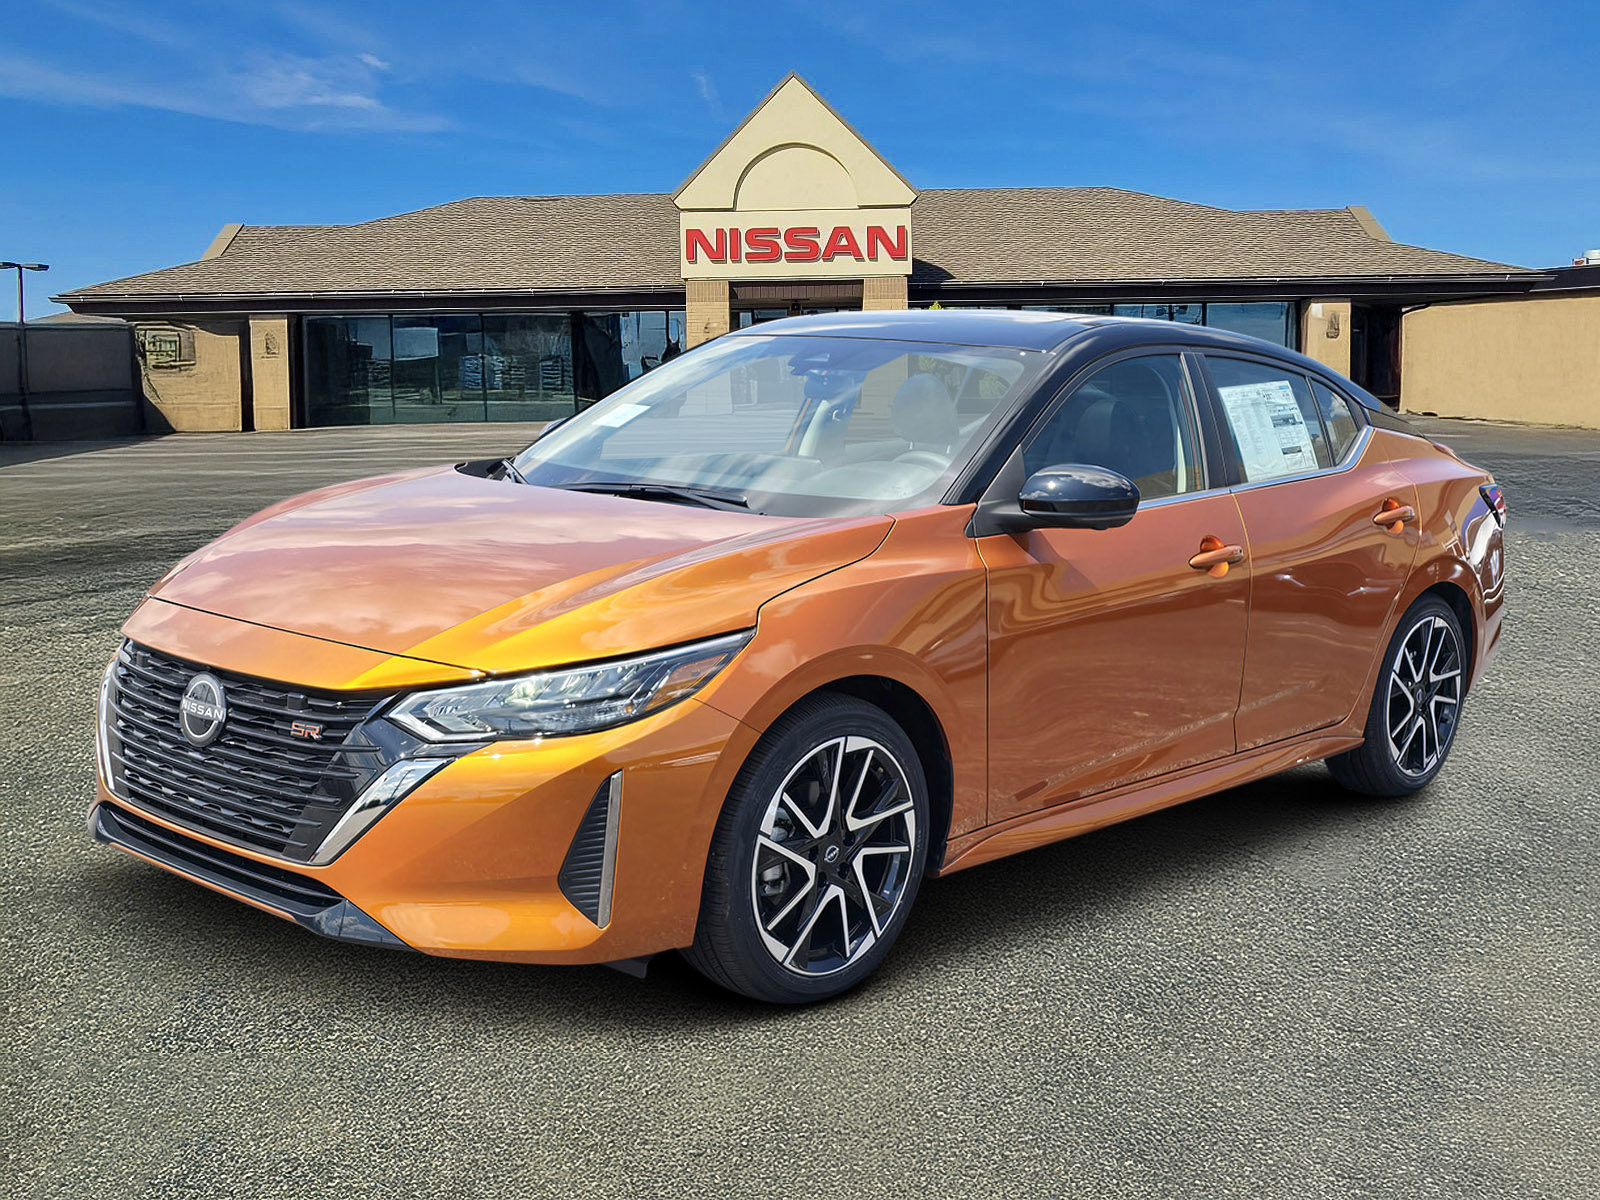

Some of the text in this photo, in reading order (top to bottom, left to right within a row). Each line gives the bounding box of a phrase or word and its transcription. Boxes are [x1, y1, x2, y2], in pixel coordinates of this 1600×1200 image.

[685, 225, 908, 264] NISSAN
[182, 699, 223, 721] NISSAN
[291, 722, 322, 740] SR
